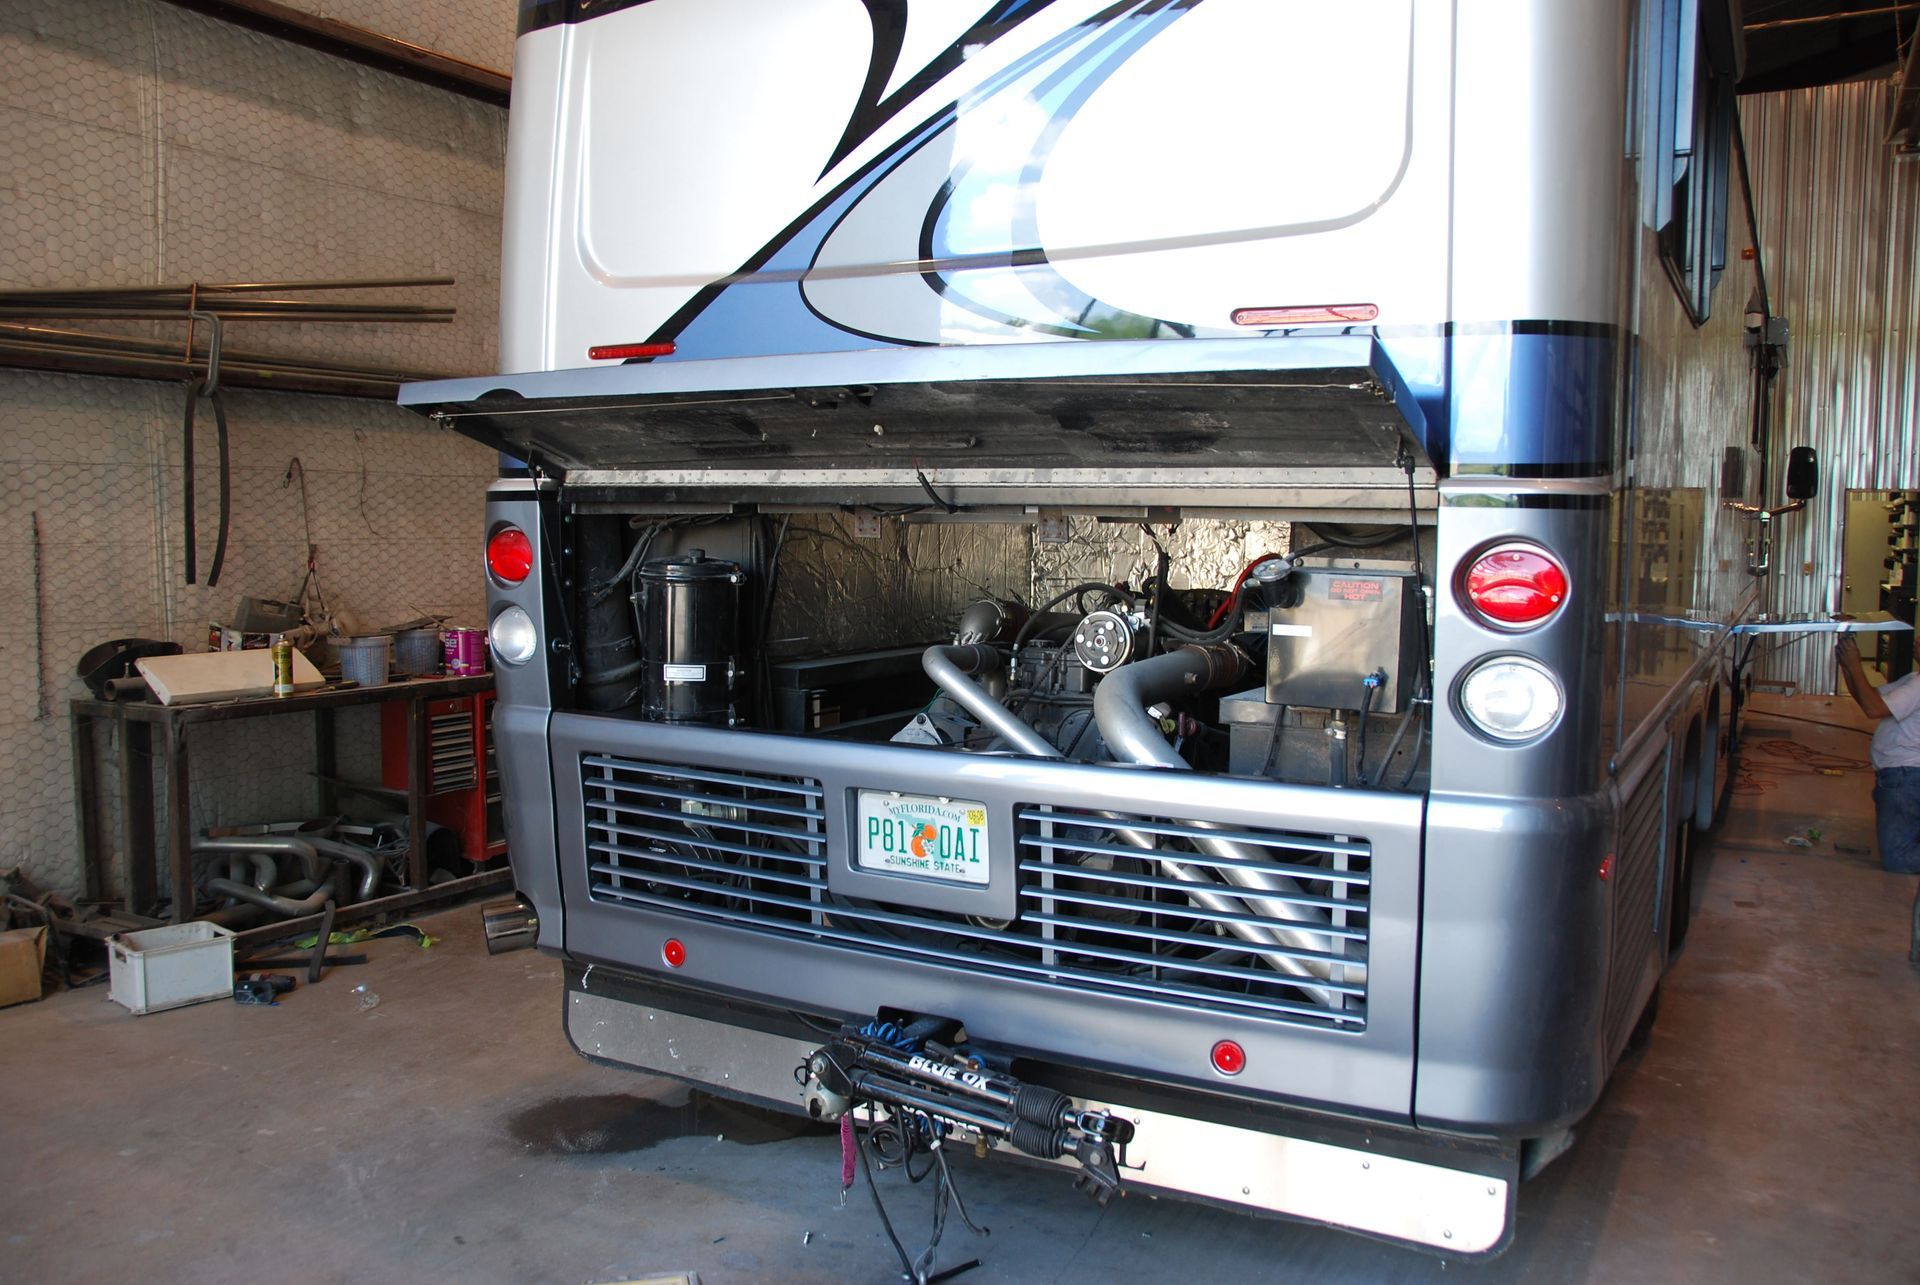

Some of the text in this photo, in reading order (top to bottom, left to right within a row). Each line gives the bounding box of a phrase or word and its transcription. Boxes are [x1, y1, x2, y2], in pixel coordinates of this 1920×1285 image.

[1332, 580, 1380, 590] CAUTION
[888, 803, 961, 823] MYFLORIDA.COM
[868, 816, 907, 854] P81
[890, 855, 960, 874] SUNSHINE STATE
[908, 1055, 992, 1091] BLUE OX
